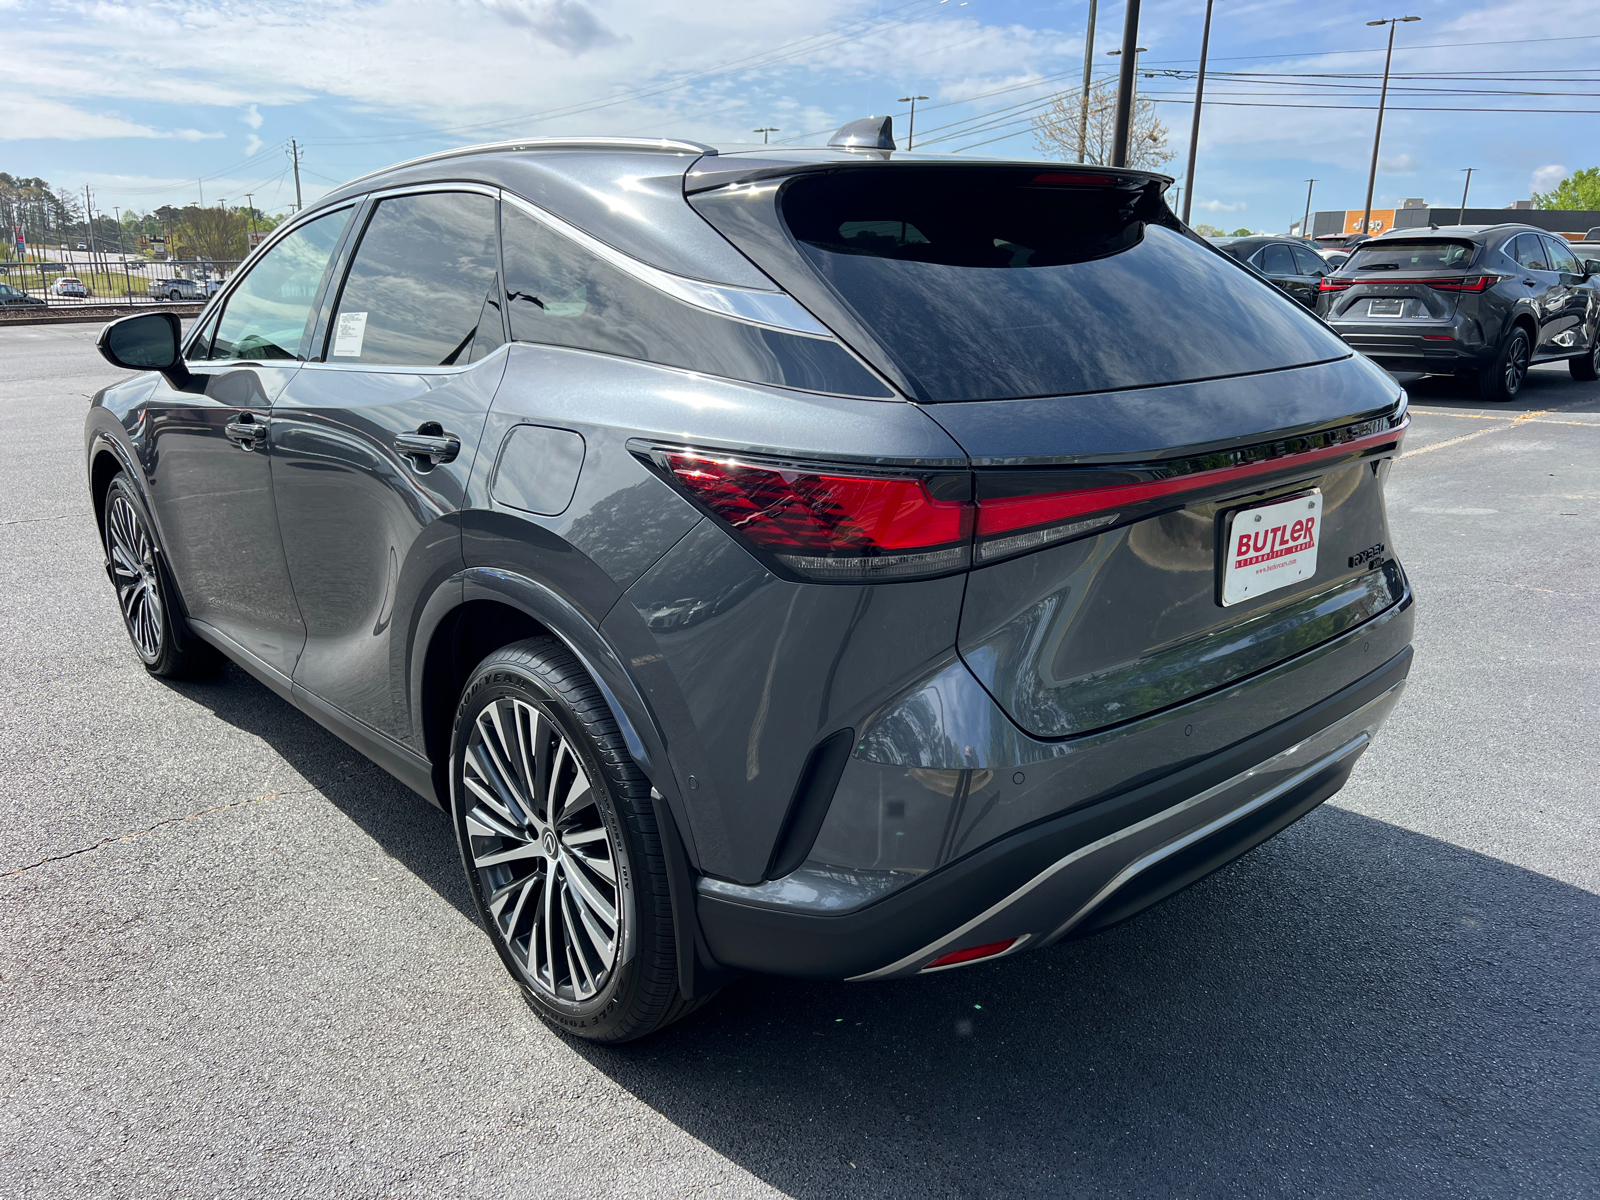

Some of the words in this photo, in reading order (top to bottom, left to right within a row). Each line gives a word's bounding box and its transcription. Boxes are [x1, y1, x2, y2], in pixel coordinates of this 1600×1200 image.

[1353, 217, 1383, 233] Jep
[1243, 425, 1360, 462] LEXUS
[1235, 547, 1286, 568] AUTOMOTIVE
[1292, 540, 1314, 553] GROUP
[1255, 559, 1297, 575] www.butlercars.com
